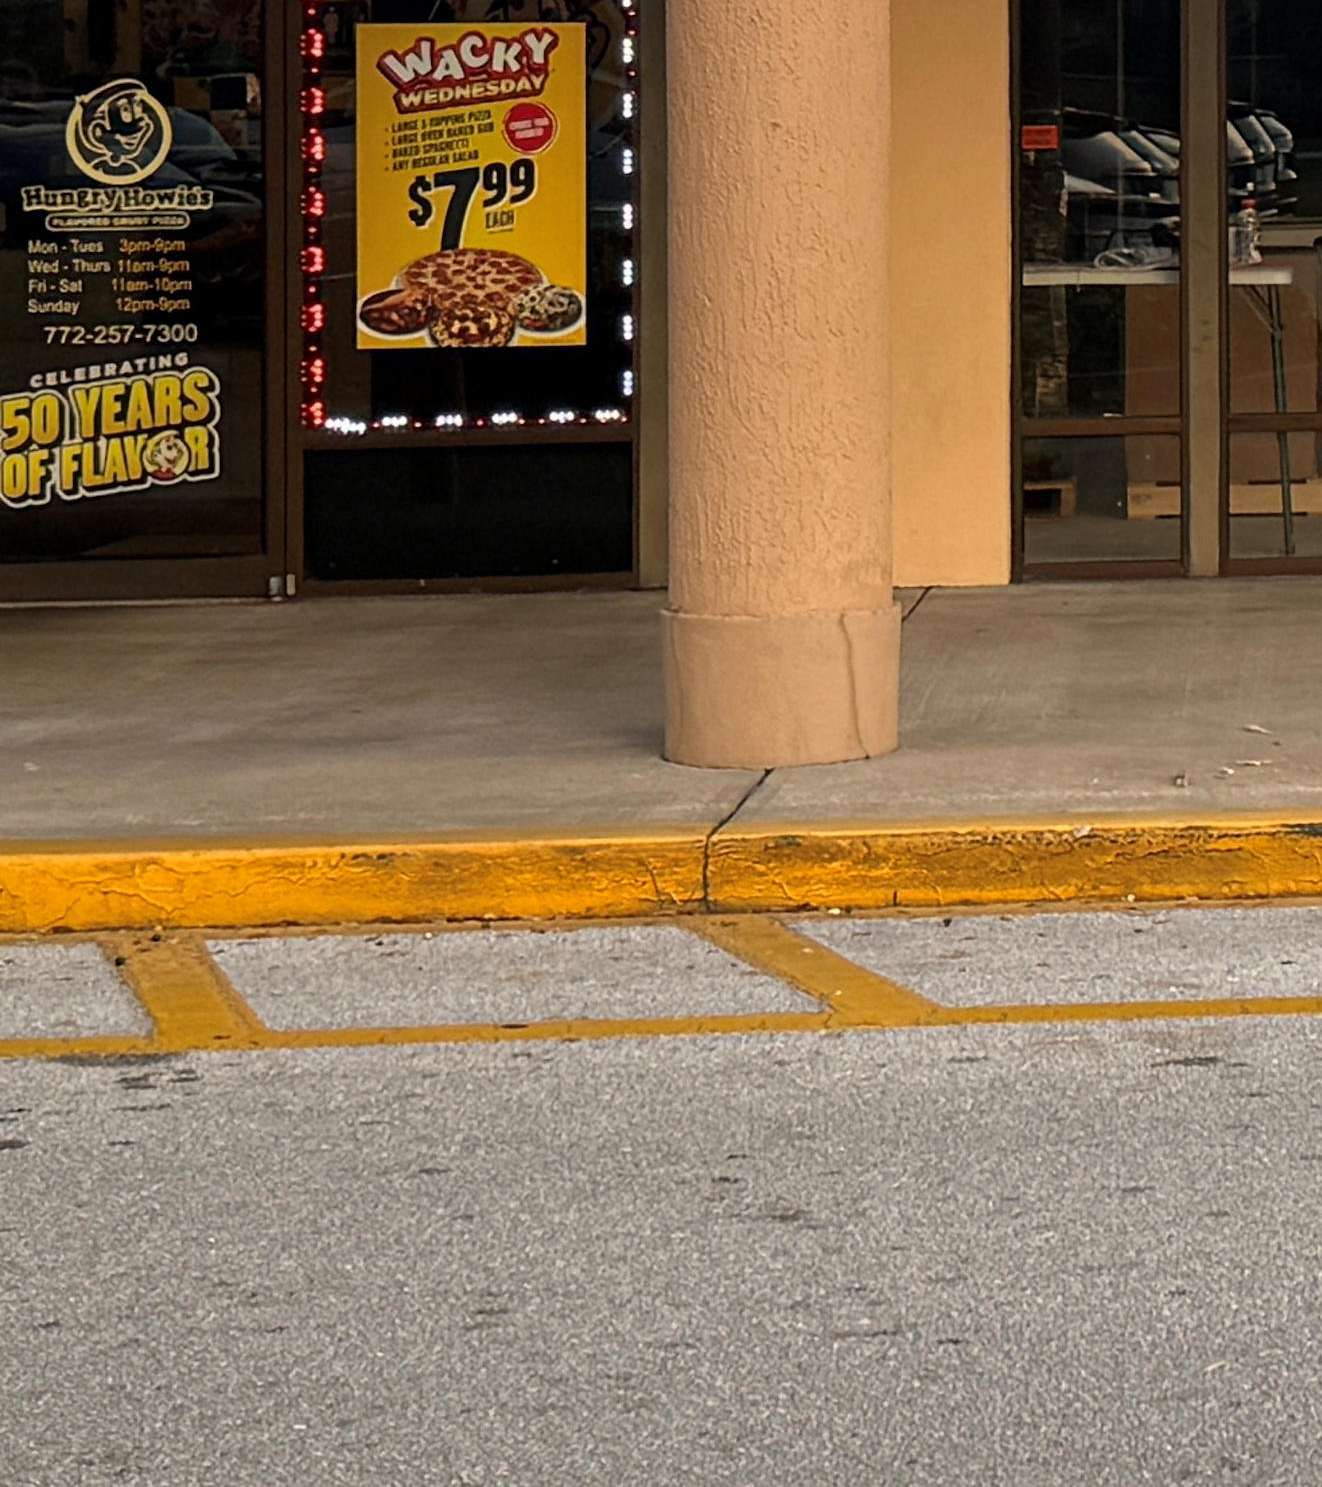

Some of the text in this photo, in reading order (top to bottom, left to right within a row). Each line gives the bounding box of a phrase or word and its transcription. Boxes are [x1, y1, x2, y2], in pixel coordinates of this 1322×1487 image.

[384, 31, 554, 83] WACKY
[400, 74, 546, 108] WEDNESDAY
[22, 184, 214, 212] Hungry Howie's
[27, 240, 58, 254] Mon
[71, 240, 104, 254] Tues
[27, 259, 59, 273] Wed
[73, 259, 111, 273] Thurs
[28, 279, 49, 293] Fri
[59, 279, 83, 293] Sat
[27, 300, 81, 315] Sunday
[43, 323, 199, 345] 772-257-7300
[29, 351, 189, 388] CELEBRATING
[1, 371, 211, 451] 50 YEARS
[2, 448, 50, 499] OF
